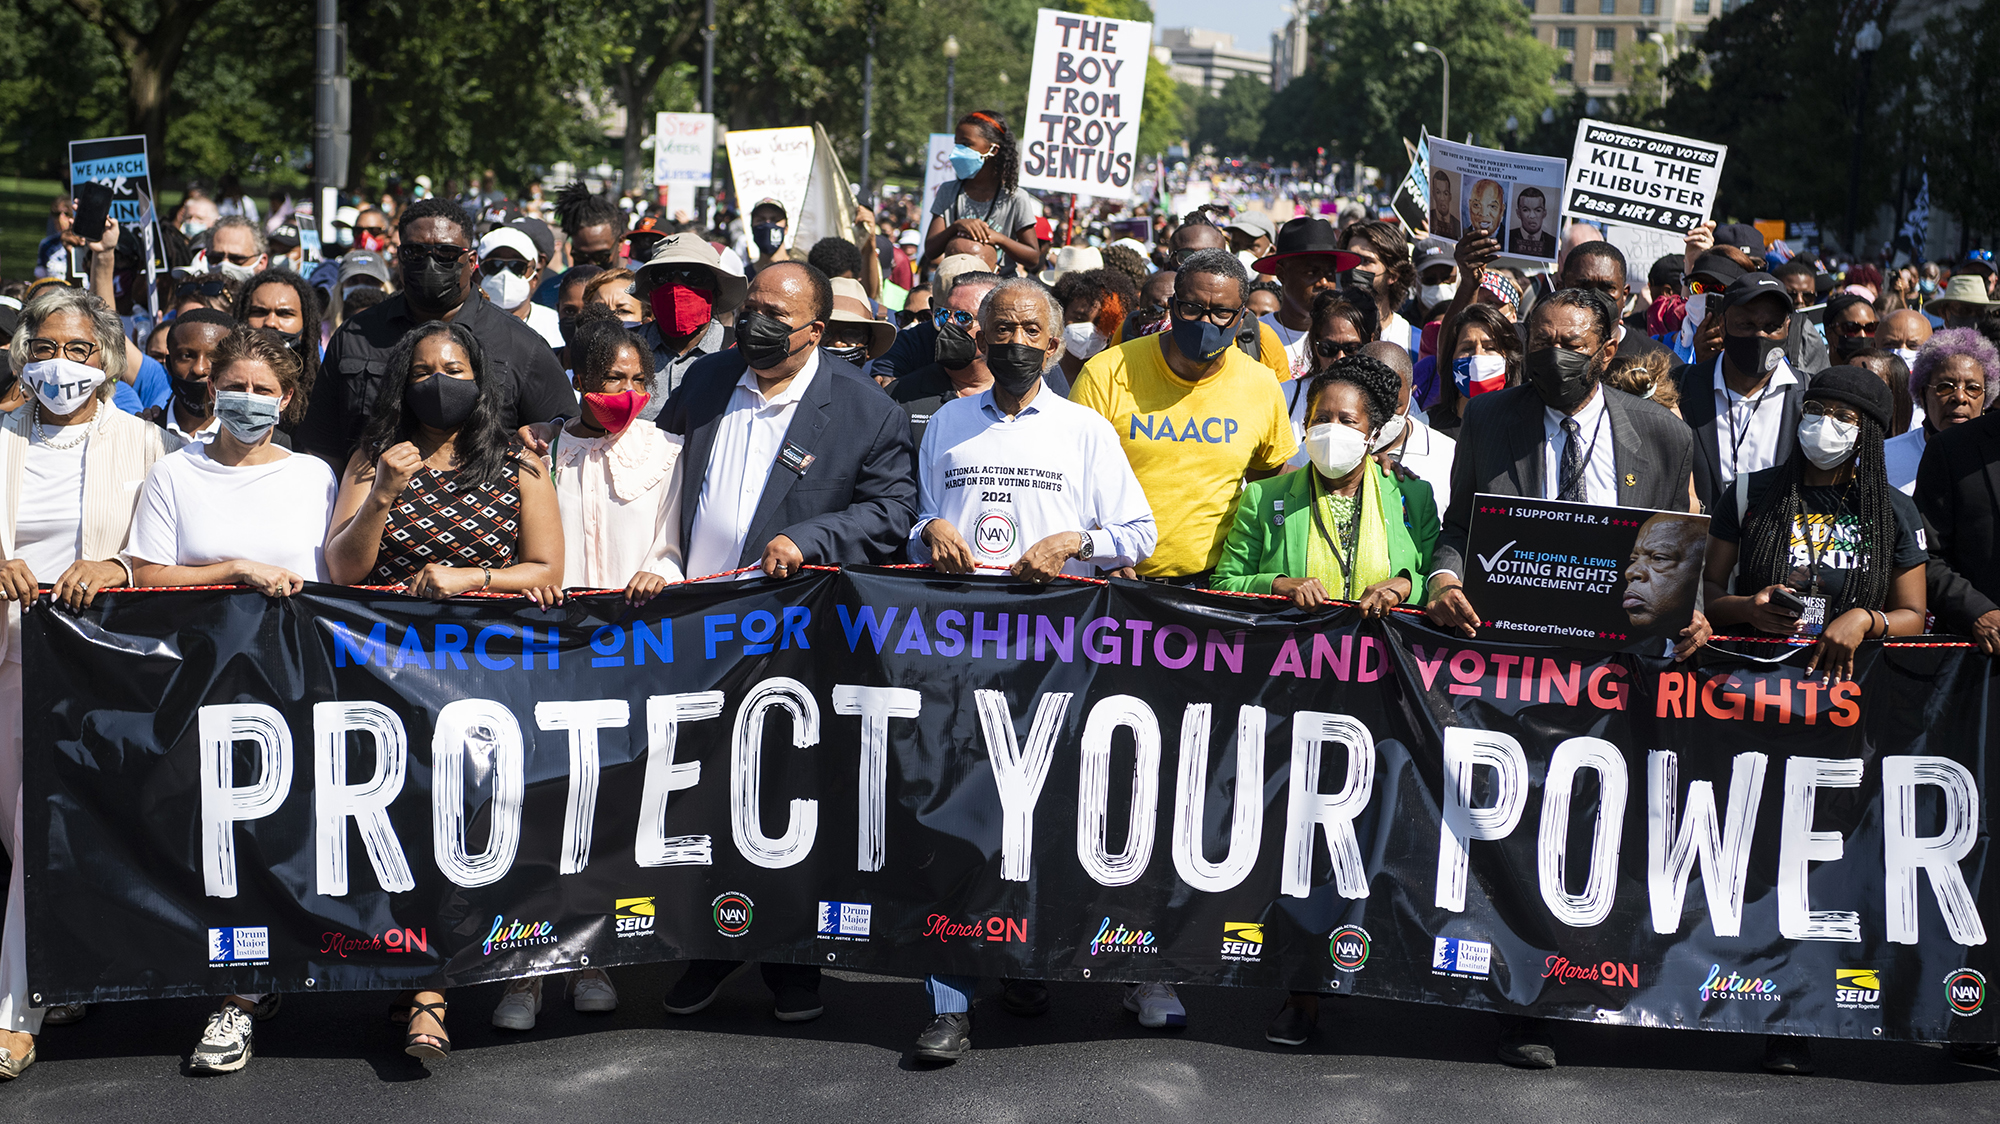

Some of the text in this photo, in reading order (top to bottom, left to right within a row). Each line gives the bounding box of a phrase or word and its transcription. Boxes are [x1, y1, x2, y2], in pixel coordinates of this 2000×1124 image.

[1056, 17, 1119, 54] THE
[1055, 52, 1124, 87] BOY
[1045, 86, 1120, 118] FROM
[665, 114, 706, 136] STOP
[1040, 114, 1128, 151] TROY
[1589, 129, 1716, 163] PROTECT OUR VOTES
[74, 160, 143, 177] WE MARCH
[1456, 166, 1488, 177] CONGRESSMAN
[1474, 157, 1486, 165] MOST
[1487, 160, 1512, 169] POWERFUL
[1513, 164, 1544, 173] NONVIOLENT
[1590, 148, 1702, 185] KILL THE
[1576, 168, 1705, 208] FILIBUSTER
[1574, 193, 1700, 230] Pass HR1 & S1
[1130, 413, 1238, 443] NAACP
[945, 466, 1063, 481] NATIONAL ACTION NETWORK
[945, 476, 1062, 492] MARCH ON FOR VOTING RIGHTS
[981, 491, 1012, 503] 2021
[1508, 507, 1609, 526] I SUPPORT H.R. 4
[980, 527, 1010, 542] NAN
[1513, 550, 1617, 568] THE JOHN R. LEWIS
[1556, 564, 1618, 583] RIGHTS
[1487, 573, 1613, 594] ADVANCEMENT ACT
[1495, 619, 1596, 638] #RestoreTheVote
[333, 604, 1862, 727] MARCH ON FOR WASHINGTON AND VOTING RIGHTS
[198, 677, 1987, 946] PROTECT YOUR POWER
[720, 908, 746, 922] NAN
[843, 905, 869, 915] Drum
[615, 916, 655, 932] SEIU
[841, 924, 868, 932] Institute
[842, 914, 868, 925] Major
[922, 913, 1028, 943] March ON
[236, 930, 266, 939] Drum
[320, 927, 428, 957] March ON
[482, 914, 553, 956] future
[493, 935, 559, 950] COALITION
[1090, 916, 1155, 956] future
[236, 939, 266, 948] Major
[1100, 945, 1158, 954] COALITION
[1220, 941, 1262, 956] SEIU
[1336, 941, 1363, 957] NAN
[1461, 942, 1489, 953] Drum
[1460, 951, 1488, 962] Major
[1458, 961, 1488, 970] Institute
[1541, 955, 1639, 988] March ON
[1698, 963, 1777, 1002] future
[1711, 991, 1781, 1001] COALITION
[1835, 990, 1880, 1003] SEIU
[1952, 985, 1980, 1000] NAN
